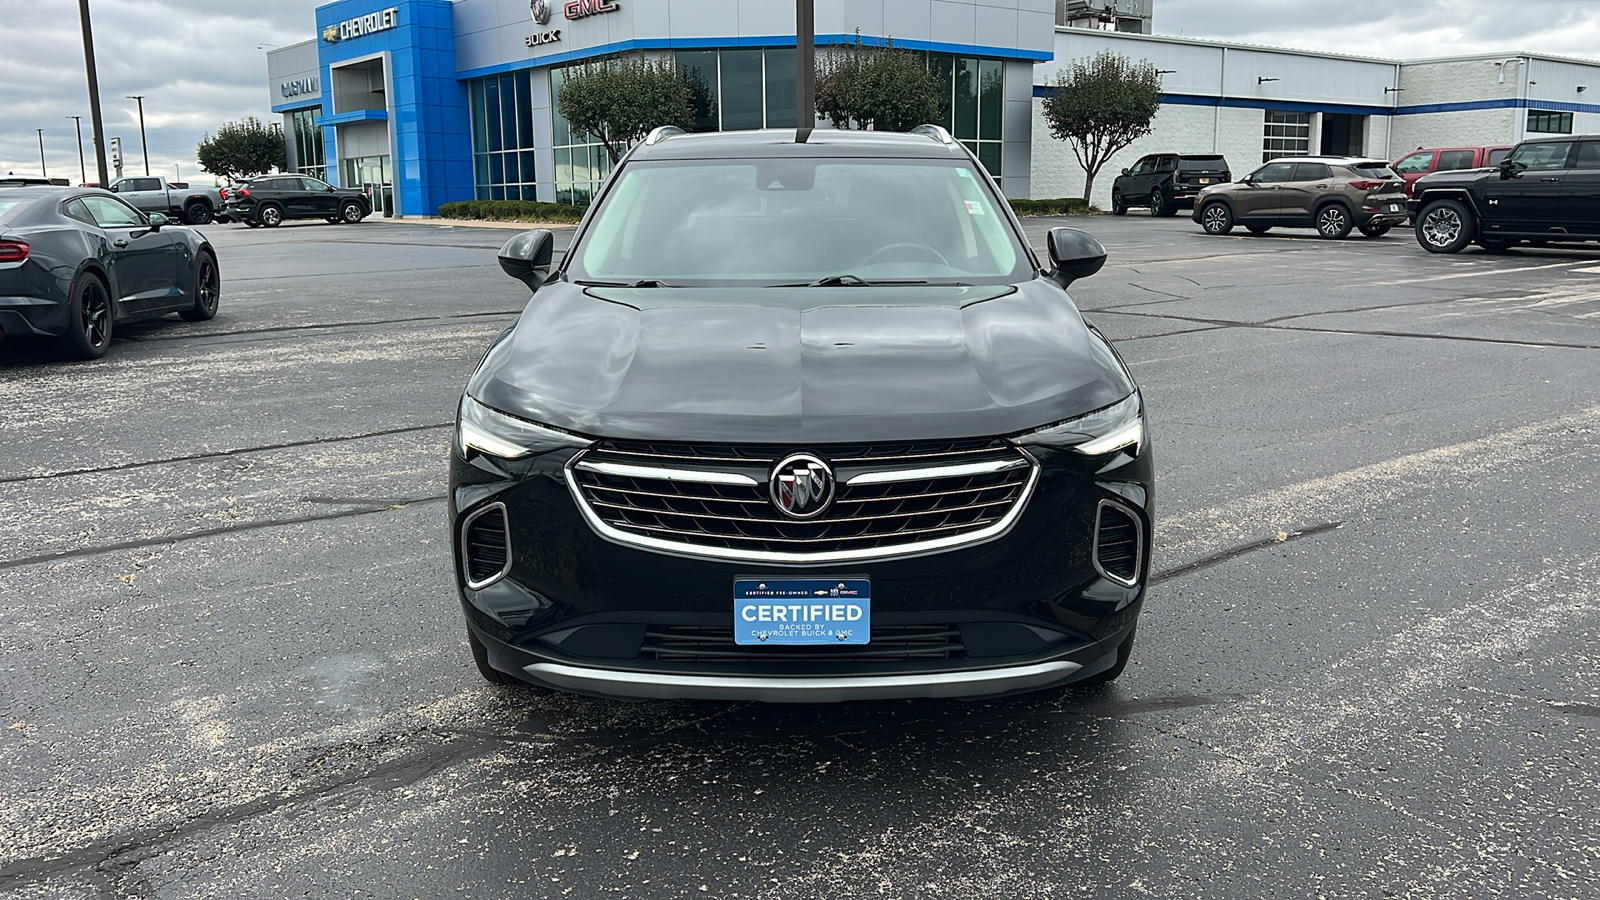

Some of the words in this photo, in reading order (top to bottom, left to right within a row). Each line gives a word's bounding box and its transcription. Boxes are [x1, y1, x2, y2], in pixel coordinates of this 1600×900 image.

[564, 0, 617, 19] GMC
[340, 7, 397, 40] CHEVROLET
[525, 29, 560, 47] BUICK
[741, 604, 863, 622] CERTIFIED
[801, 629, 826, 637] BUICK
